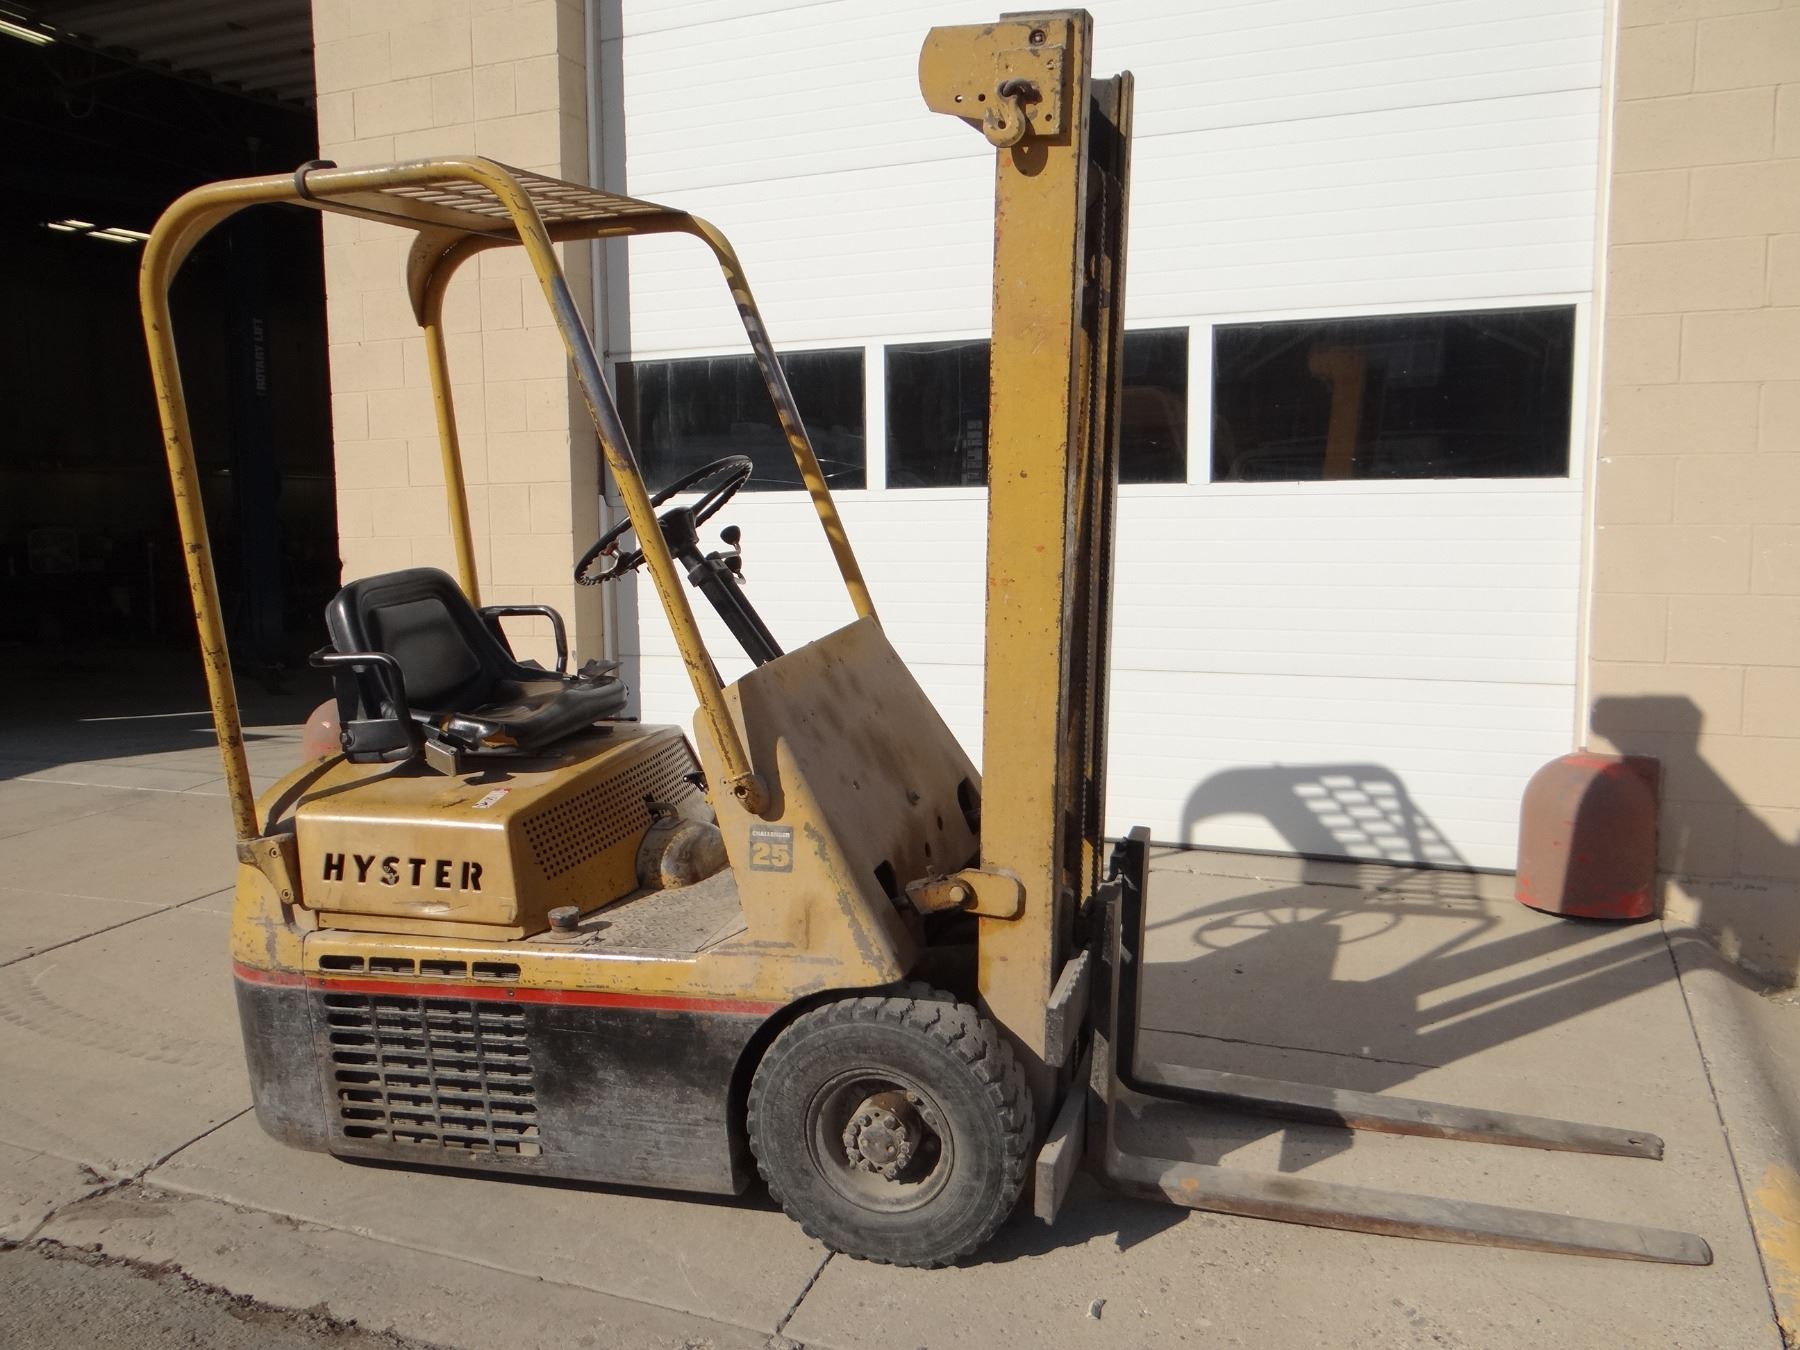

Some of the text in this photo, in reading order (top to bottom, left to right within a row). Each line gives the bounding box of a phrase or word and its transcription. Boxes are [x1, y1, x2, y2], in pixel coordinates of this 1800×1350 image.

[253, 318, 264, 342] LIFT
[752, 842, 790, 867] 25
[322, 852, 484, 892] HYSTER
